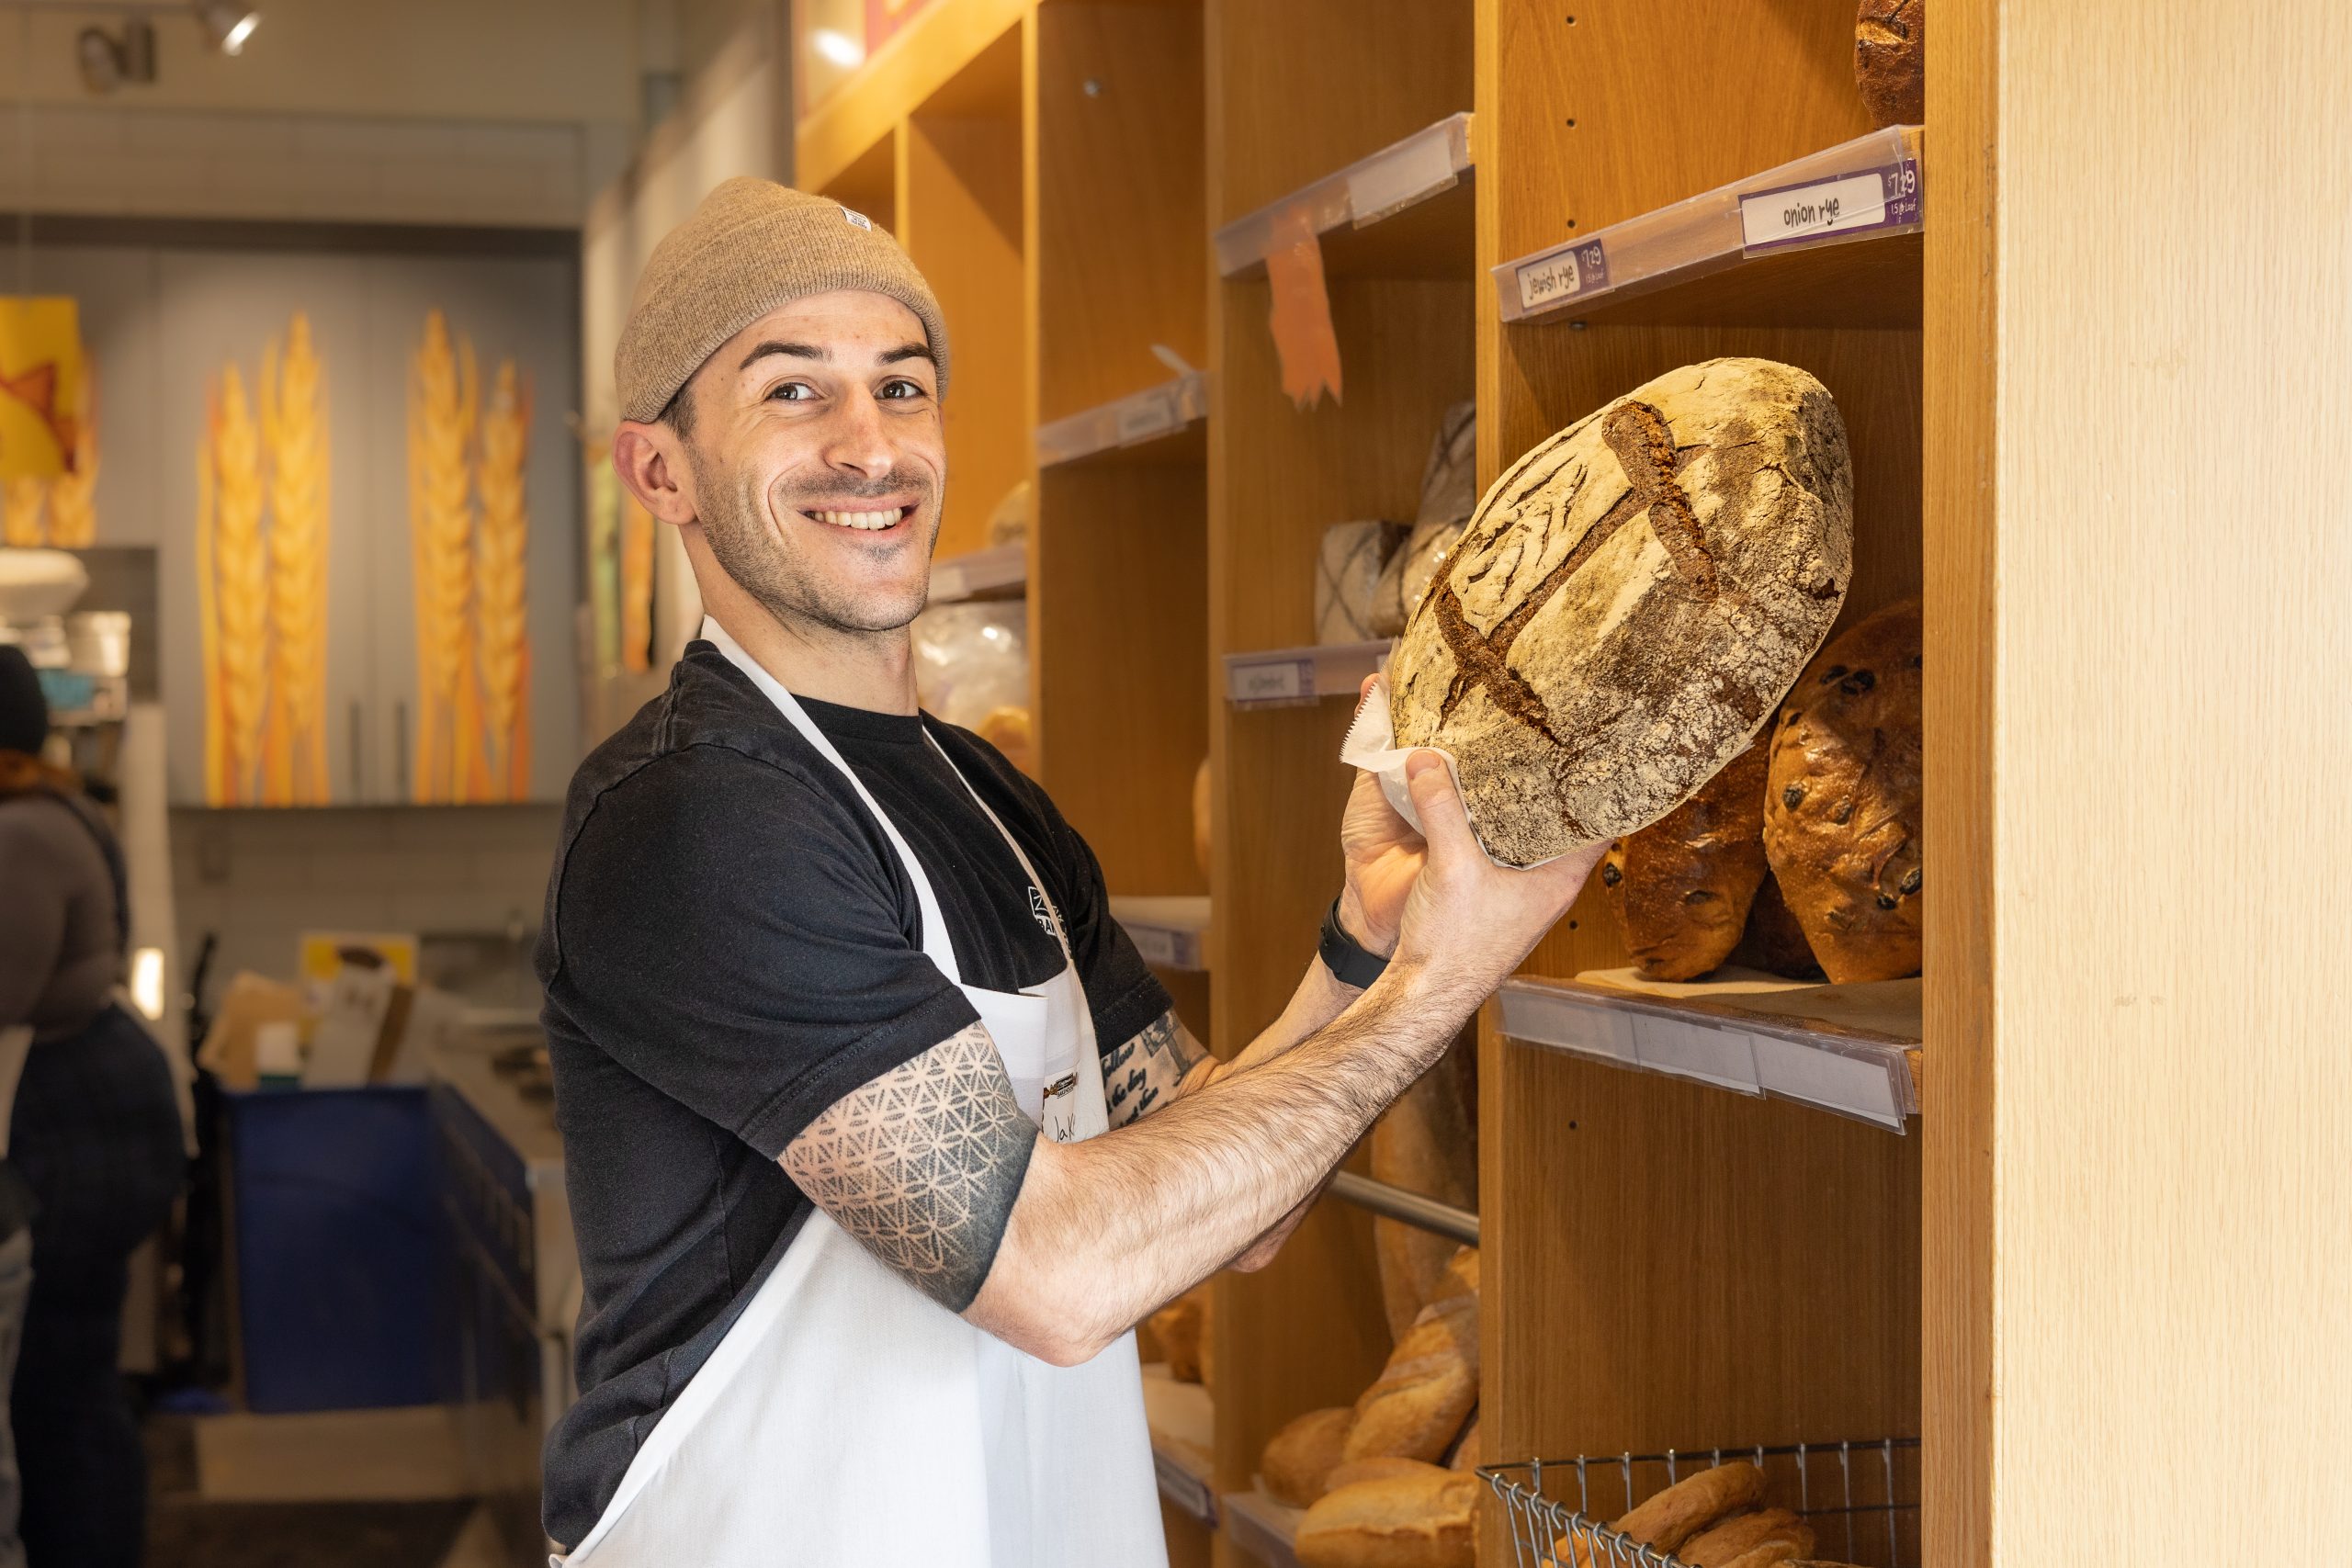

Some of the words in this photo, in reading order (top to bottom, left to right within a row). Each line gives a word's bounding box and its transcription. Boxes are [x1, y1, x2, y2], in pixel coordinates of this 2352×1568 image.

[1783, 202, 1815, 228] onion
[1818, 197, 1839, 226] rye
[1527, 266, 1556, 300] jewish
[1558, 265, 1575, 289] rye
